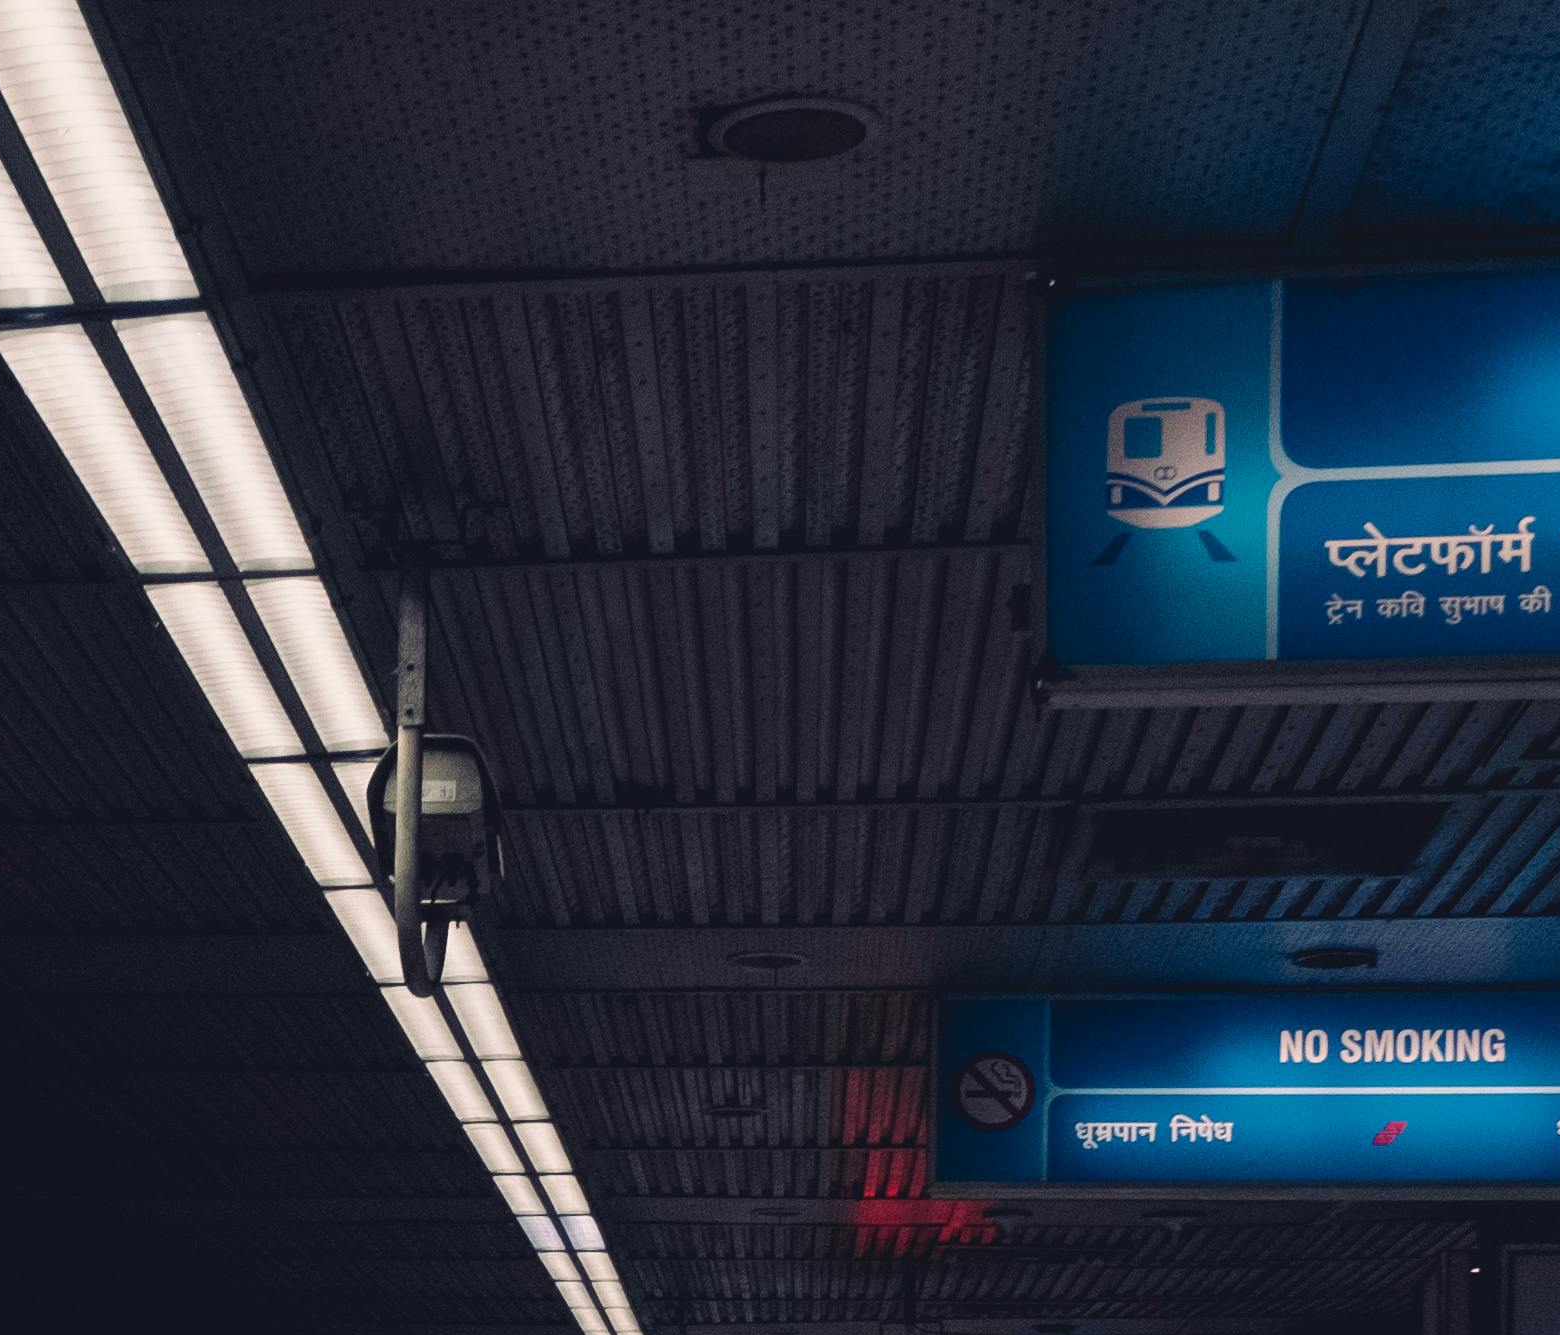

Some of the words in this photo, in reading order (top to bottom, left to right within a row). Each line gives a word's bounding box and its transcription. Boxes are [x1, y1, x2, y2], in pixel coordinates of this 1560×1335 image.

[1325, 516, 1535, 576] प्लेटफॉर्म
[1326, 594, 1362, 624] ट्रेन
[1377, 591, 1425, 617] कवि
[1440, 595, 1505, 624] सुभाष
[1520, 586, 1551, 612] की
[1280, 1030, 1328, 1063] NO
[1340, 1029, 1505, 1063] SMOKING
[1076, 1122, 1157, 1148] धूम्रपान
[1170, 1114, 1233, 1142] निषेध
